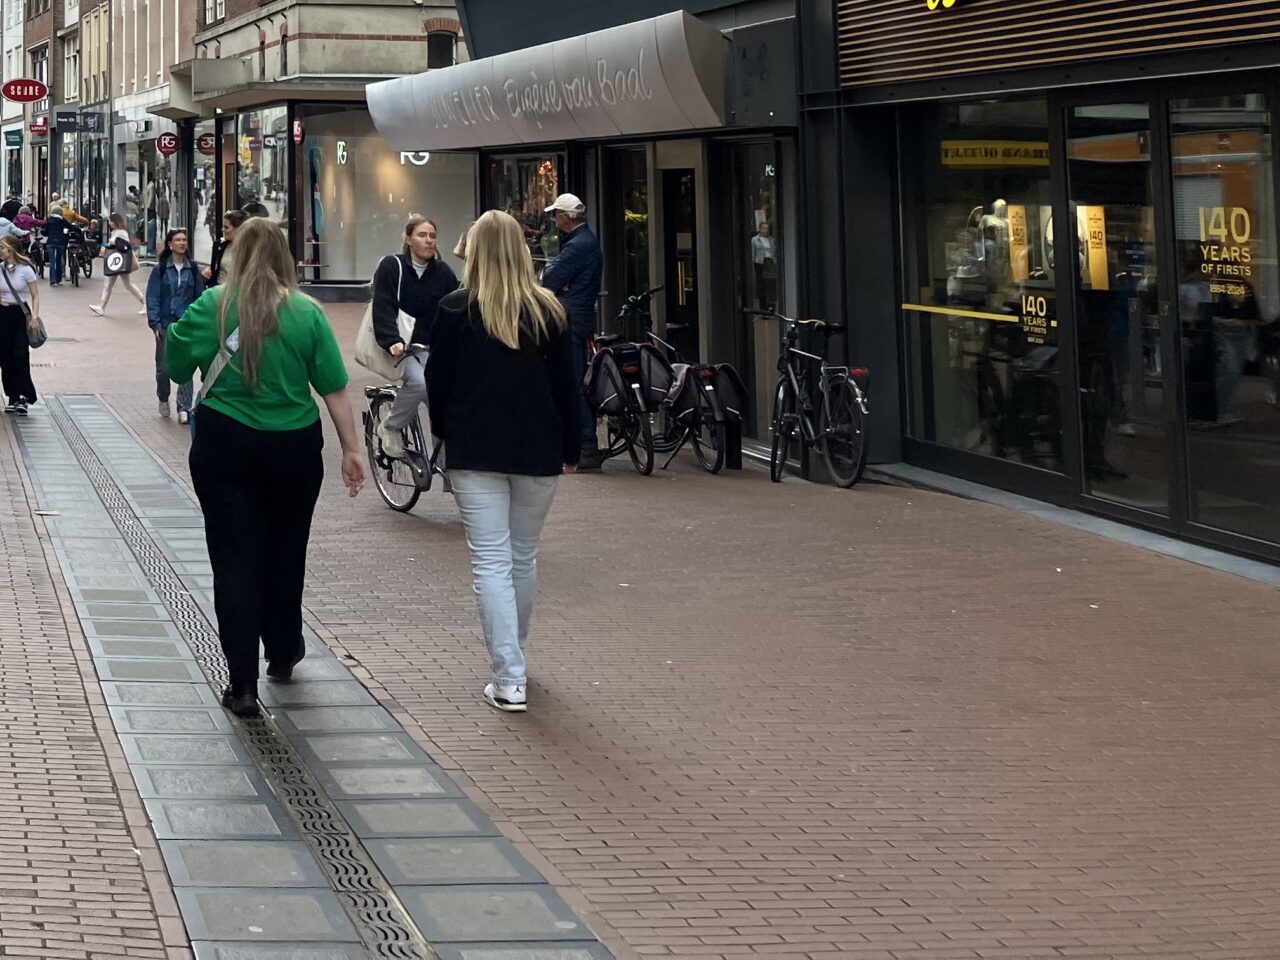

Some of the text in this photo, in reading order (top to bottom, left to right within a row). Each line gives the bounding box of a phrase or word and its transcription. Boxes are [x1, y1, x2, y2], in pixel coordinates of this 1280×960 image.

[1198, 206, 1251, 244] 140
[1089, 230, 1103, 241] 140
[1200, 245, 1252, 263] YEARS
[1201, 263, 1252, 276] OF FIRSTS
[1022, 294, 1047, 317] 140
[1022, 316, 1047, 327] YEARS
